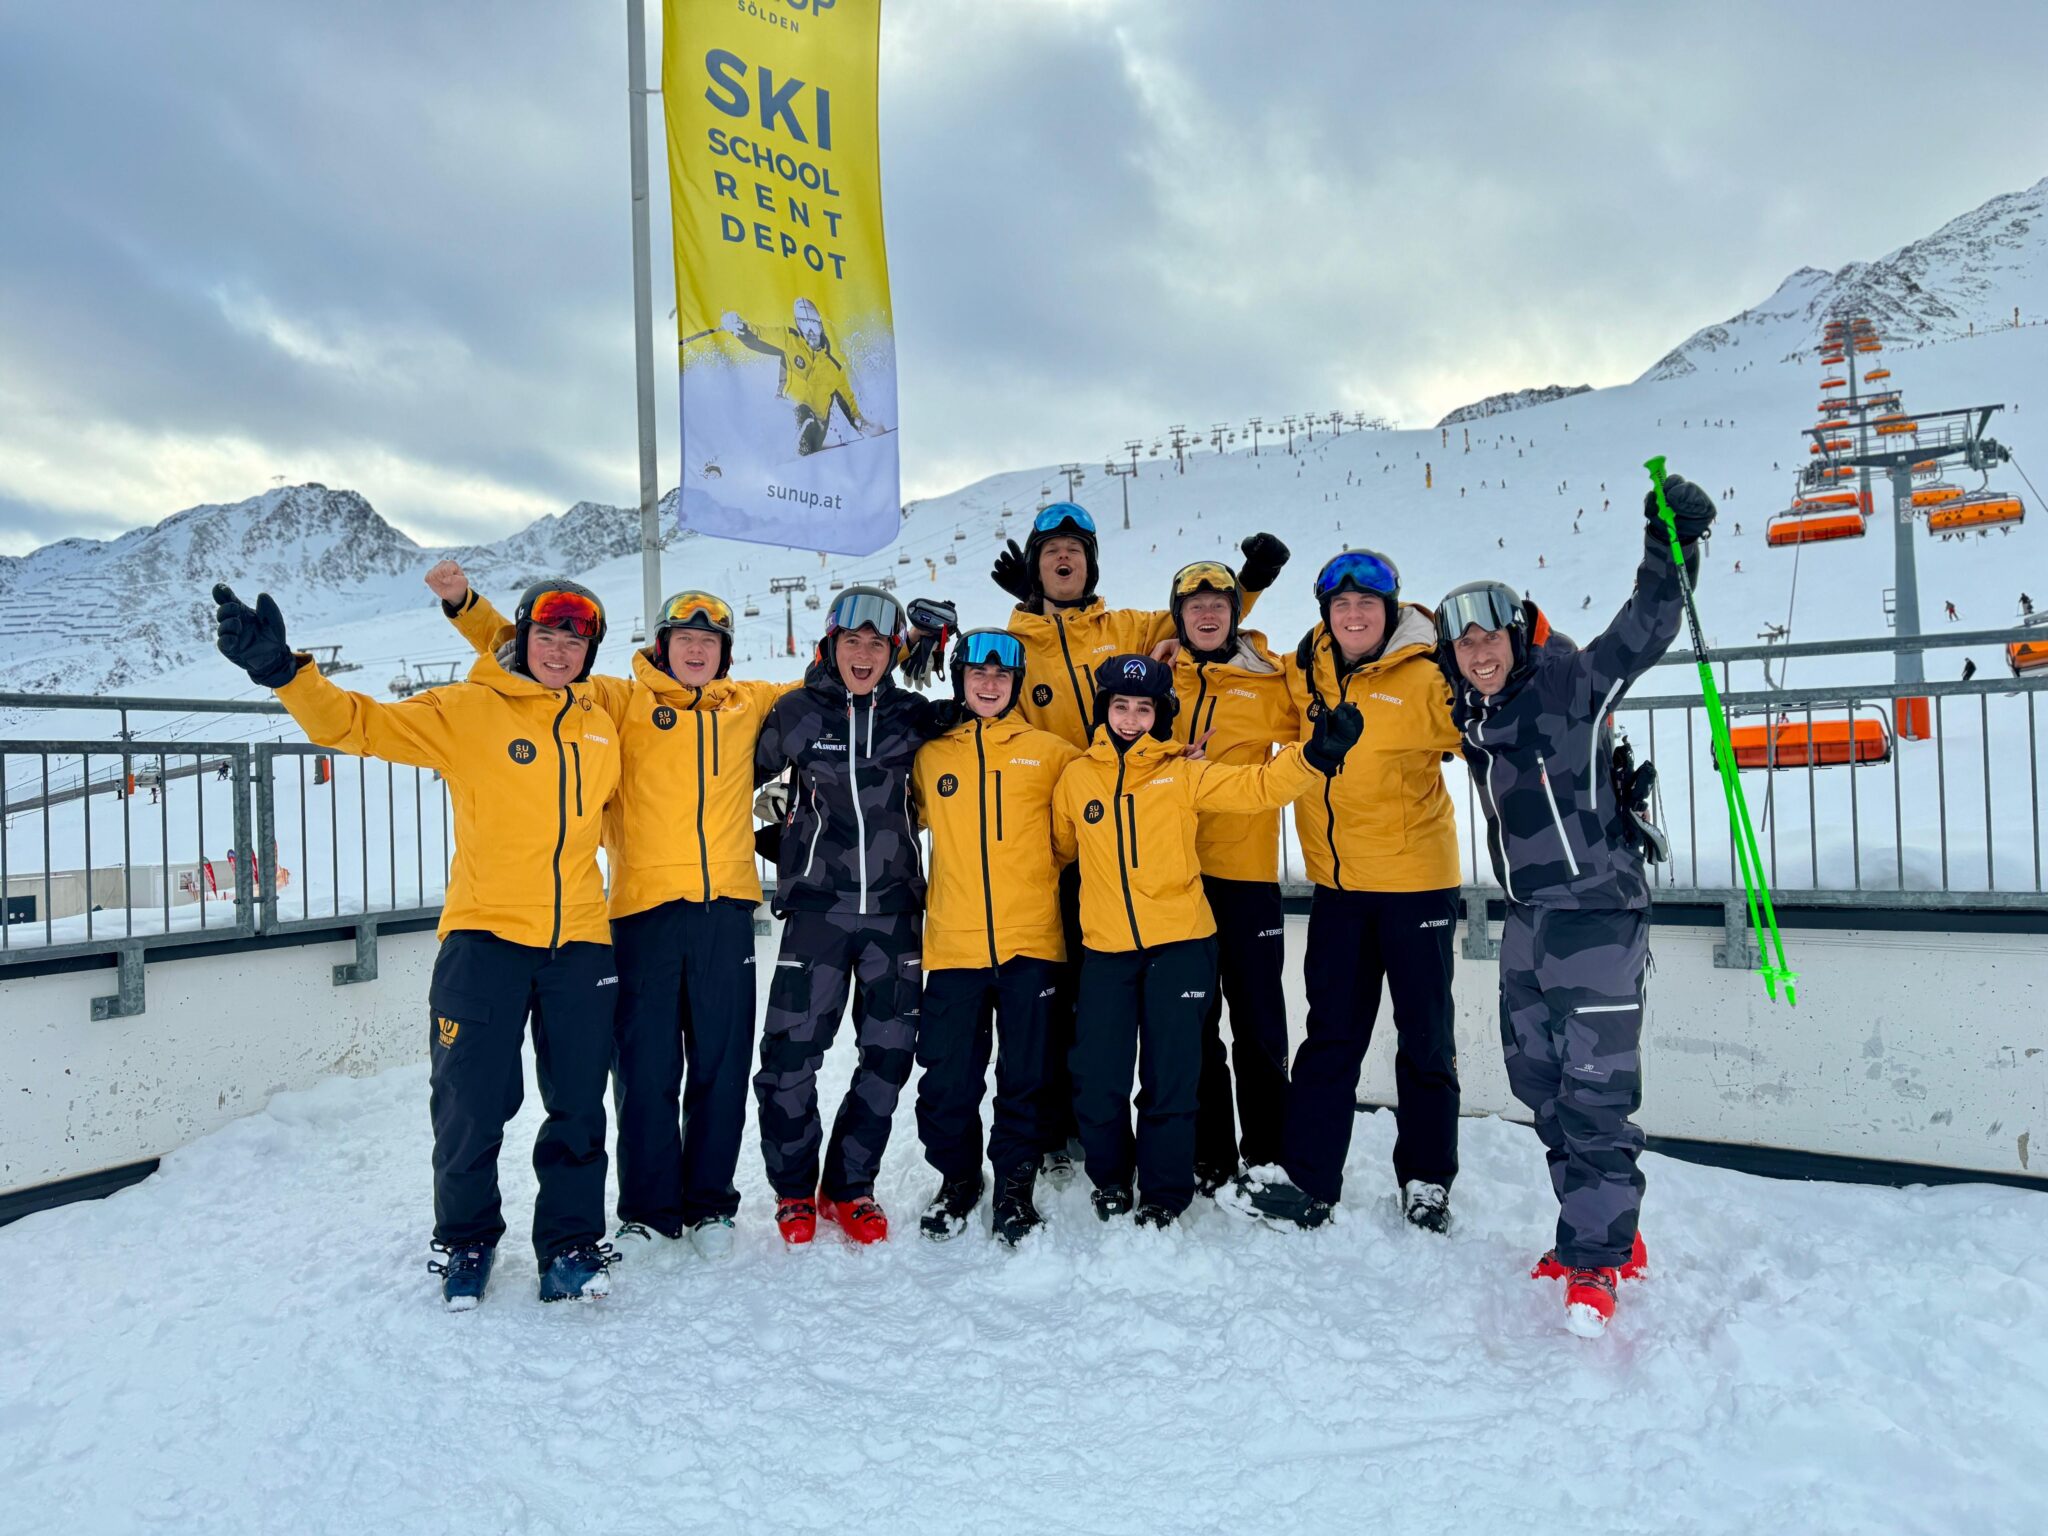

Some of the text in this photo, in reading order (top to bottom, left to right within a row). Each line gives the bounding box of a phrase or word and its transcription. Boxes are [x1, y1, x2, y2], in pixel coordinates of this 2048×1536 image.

[738, 0, 799, 33] SÖLDEN
[704, 48, 832, 152] SKI
[708, 127, 840, 197] SCHOOL
[714, 169, 842, 238] RENT
[721, 212, 846, 280] DEPOT
[767, 483, 842, 510] sunup.at
[1378, 693, 1403, 706] TERREX
[1017, 758, 1041, 767] TERREX
